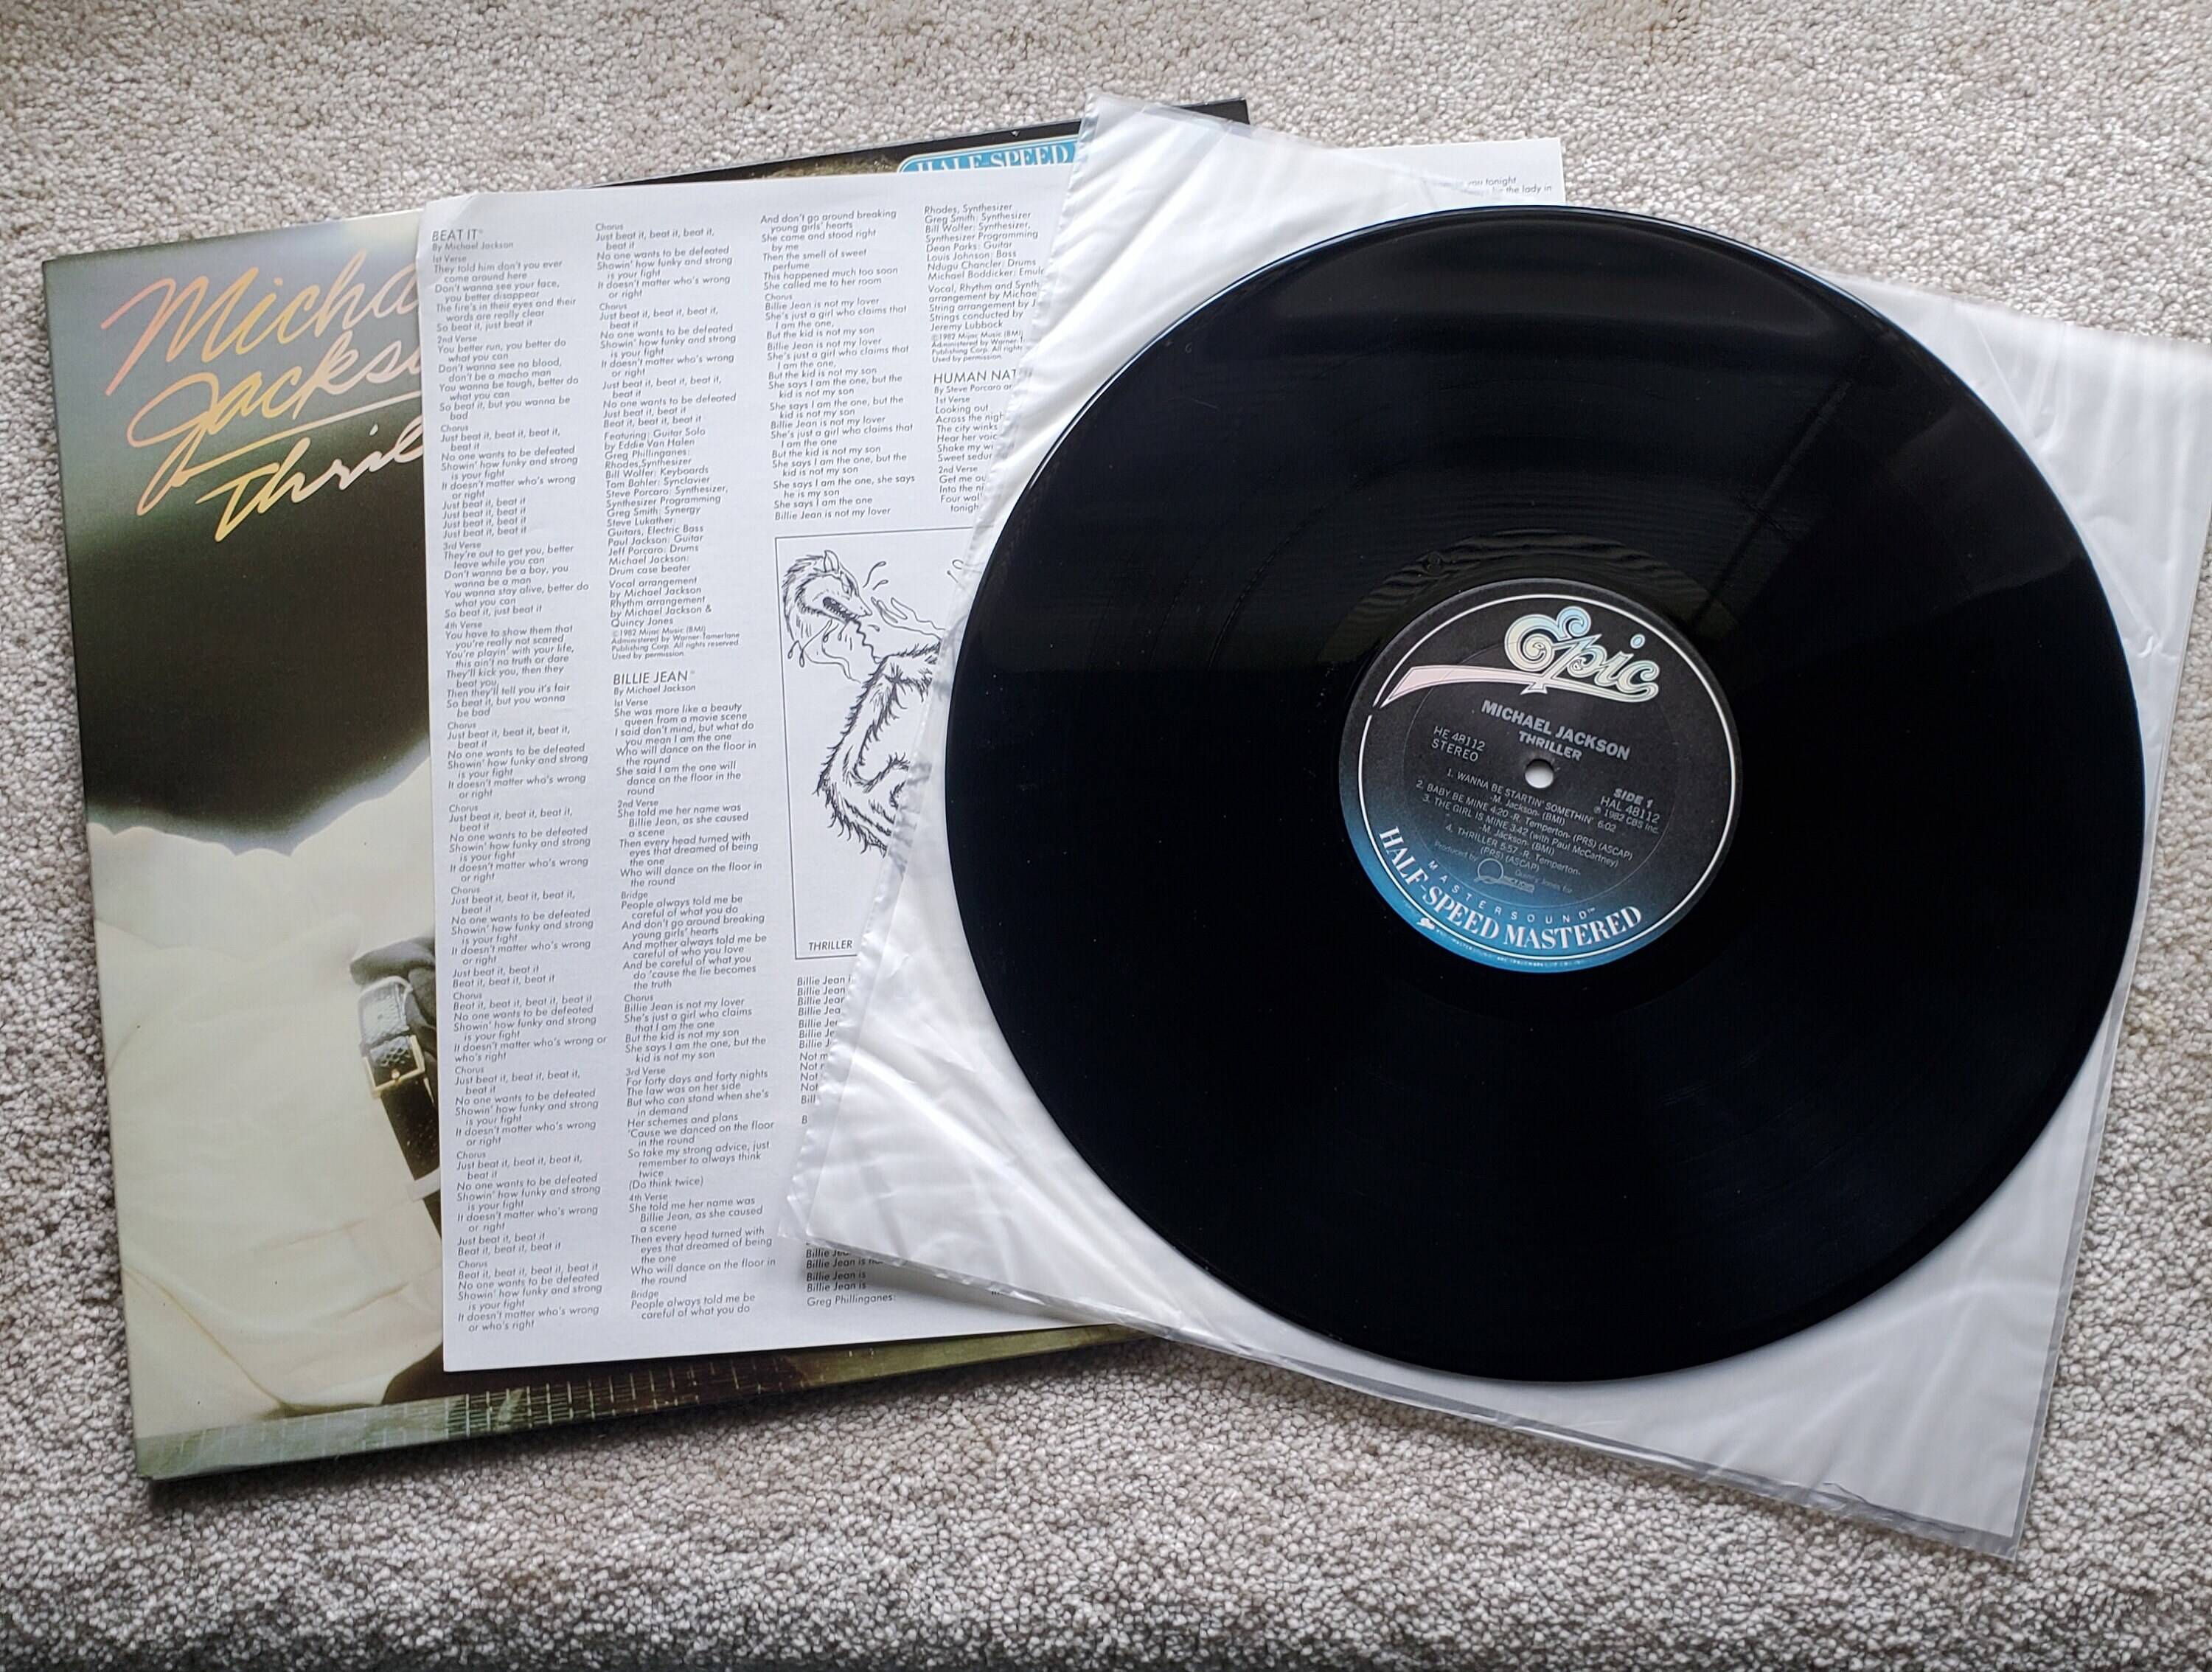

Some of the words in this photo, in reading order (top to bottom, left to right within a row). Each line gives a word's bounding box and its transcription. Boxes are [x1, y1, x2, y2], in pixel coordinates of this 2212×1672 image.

[1485, 176, 1517, 187] tonight
[1522, 185, 1542, 195] lady
[963, 204, 1012, 215] Synthesizer
[761, 214, 779, 223] And
[782, 214, 804, 223] don't
[807, 215, 819, 225] go
[821, 211, 854, 220] around
[857, 209, 897, 219] breaking
[596, 223, 623, 232] Chorus
[432, 229, 463, 242] BEAT
[432, 243, 442, 253] By
[445, 241, 478, 251] Michael
[481, 241, 513, 249] Jackson
[435, 264, 454, 274] They
[458, 263, 475, 271] told
[478, 263, 494, 271] him
[498, 261, 521, 271] don't
[524, 263, 540, 271] you
[931, 323, 962, 332] Jeremy
[965, 319, 1003, 330] Lubbock
[933, 370, 987, 384] HUMAN
[936, 404, 970, 414] Looking
[653, 429, 683, 438] Guitar
[686, 427, 706, 437] Solo
[776, 511, 797, 520] Billie
[801, 510, 821, 519] Jean
[825, 510, 832, 518] is
[835, 509, 849, 517] not
[869, 507, 890, 515] lover
[609, 578, 635, 589] Vocal
[639, 577, 697, 588] arrangement
[611, 618, 644, 628] Quincy
[647, 617, 673, 625] Jones
[445, 631, 462, 639] You
[465, 628, 487, 638] have
[491, 629, 499, 637] to
[503, 628, 527, 636] show
[530, 625, 552, 634] them
[555, 624, 572, 634] that
[1504, 606, 1660, 703] Epic
[613, 673, 649, 684] BILLIE
[653, 670, 687, 683] JEAN
[614, 687, 624, 696] By
[626, 684, 661, 695] Michael
[664, 683, 695, 693] Jackson
[615, 708, 631, 717] She
[683, 704, 698, 713] like
[711, 703, 742, 712] beauty
[1481, 699, 1552, 735] MICHAEL
[1555, 726, 1630, 761] JACKSON
[1433, 726, 1450, 740] HE
[1452, 732, 1486, 752] 48112
[1518, 731, 1582, 761] THRILLER
[1431, 738, 1479, 763] STEREO
[1457, 771, 1489, 790] WANNA
[1491, 783, 1504, 794] BE
[1613, 788, 1644, 805] SIDE
[1646, 799, 1653, 809] 1
[1600, 796, 1622, 811] HAL
[1625, 805, 1660, 824] 48112
[1427, 783, 1451, 797] BABY
[1452, 792, 1464, 802] BE
[1465, 796, 1489, 811] MINE
[1572, 833, 1597, 849] (PRS)
[1599, 842, 1633, 861] (ASCAP)
[1542, 812, 1565, 827] (BMI)
[1604, 808, 1625, 822] 1982
[1626, 816, 1644, 829] CBS
[1433, 797, 1453, 811] THE
[1453, 804, 1472, 818] GIRL
[1475, 811, 1484, 821] IS
[1485, 815, 1509, 830] MINE
[1529, 830, 1550, 844] (with
[1551, 838, 1571, 851] Paul
[1571, 845, 1619, 868] McCartney)
[1457, 827, 1498, 847] THRILLER
[1531, 842, 1555, 856] (BMI)
[1480, 846, 1504, 860] (PRS)
[1505, 856, 1540, 873] (ASCAP)
[1380, 826, 1499, 940] HALF-SPEED
[1504, 905, 1643, 950] MASTERED
[810, 940, 852, 951] THRILLER
[633, 969, 646, 979] do
[683, 968, 696, 977] the
[700, 966, 711, 975] lie
[714, 965, 756, 974] becomes
[630, 1180, 646, 1190] (Do
[650, 1177, 672, 1188] think
[675, 1176, 703, 1186] twice)
[459, 1280, 473, 1291] No
[498, 1279, 525, 1287] wants
[529, 1277, 538, 1286] to
[541, 1276, 553, 1285] be
[556, 1273, 599, 1283] defeated
[499, 1288, 519, 1298] how
[523, 1285, 548, 1297] funky
[551, 1283, 570, 1294] and
[573, 1285, 602, 1294] strong
[807, 1297, 831, 1308] Greg
[641, 1308, 675, 1319] careful
[678, 1307, 687, 1317] of
[691, 1306, 714, 1316] what
[717, 1306, 734, 1317] you
[737, 1303, 750, 1313] do
